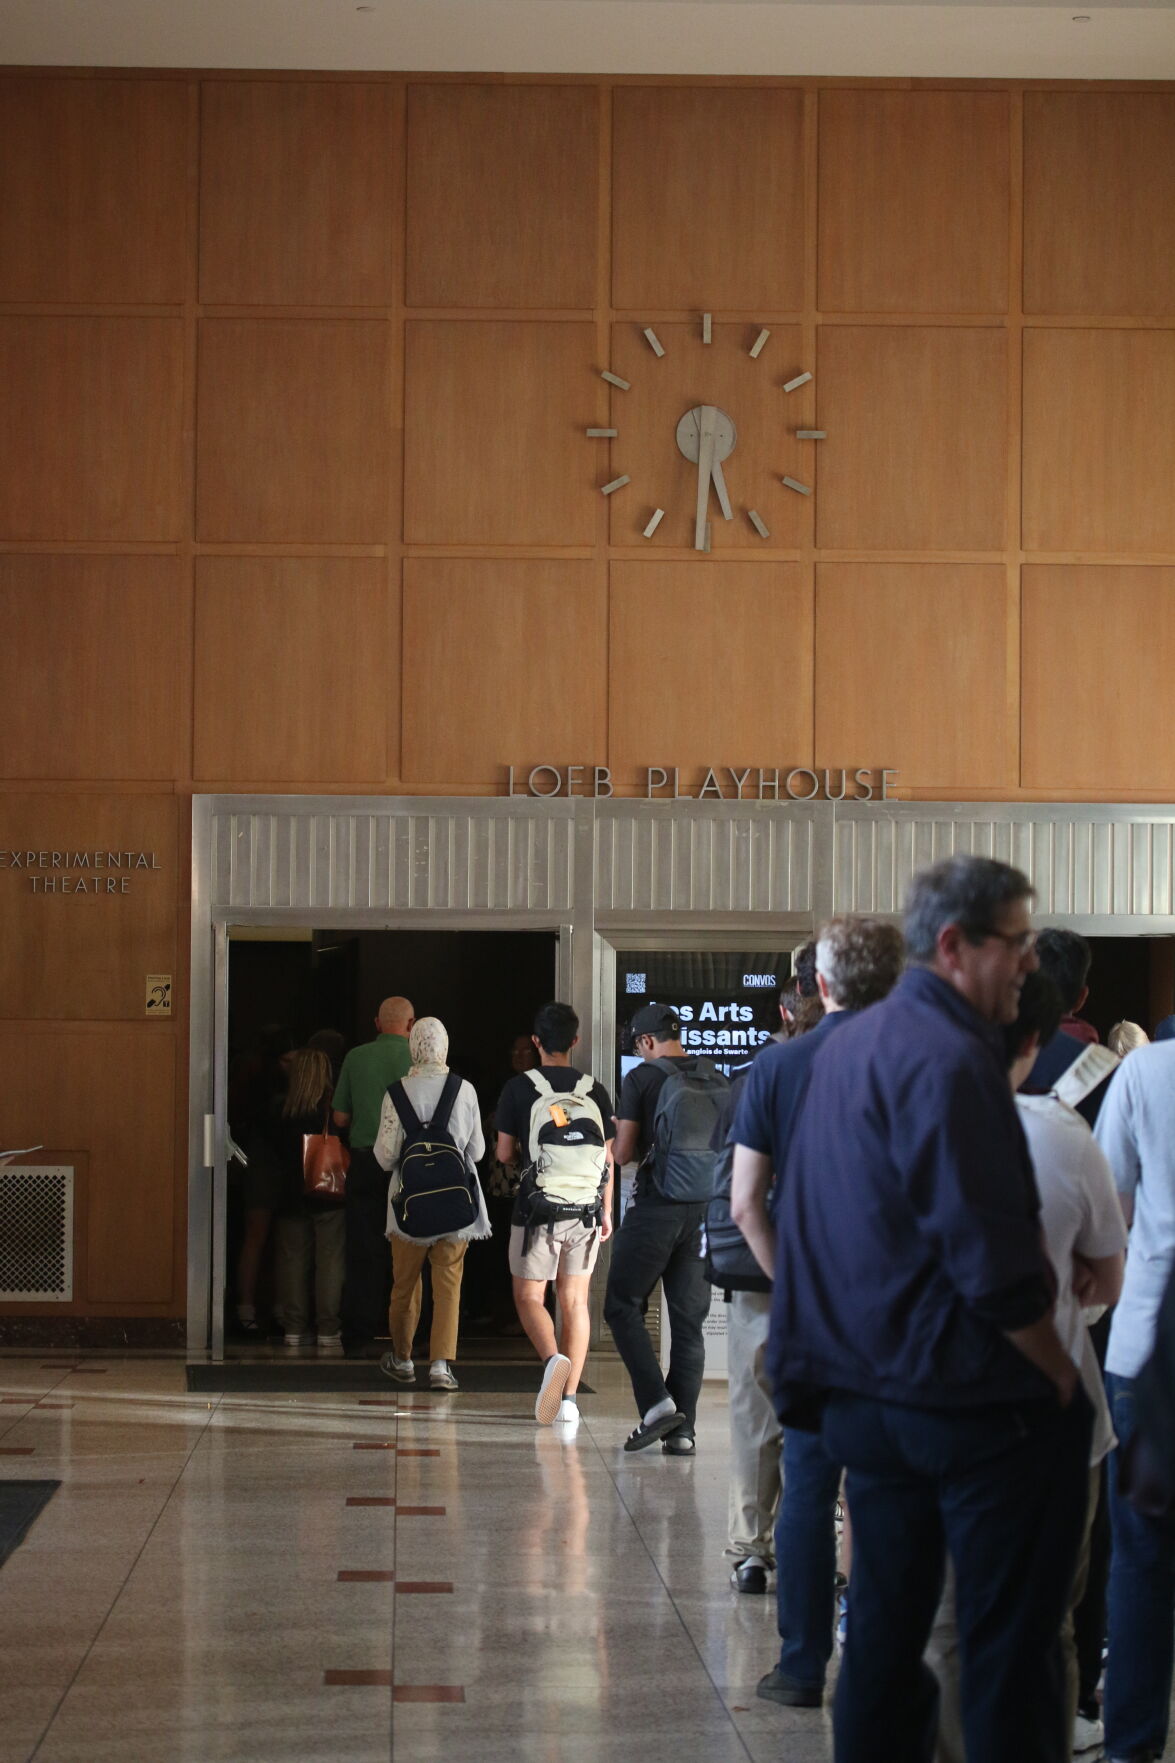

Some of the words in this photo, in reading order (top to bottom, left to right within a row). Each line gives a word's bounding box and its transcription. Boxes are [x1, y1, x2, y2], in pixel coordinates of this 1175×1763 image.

[509, 765, 614, 799] LOEB
[647, 767, 900, 801] PLAYHOUSE
[0, 851, 162, 869] EXPERIMENTAL
[29, 876, 132, 894] THEATRE
[743, 974, 776, 986] CONVOS
[699, 1002, 753, 1022] Arts
[680, 1026, 771, 1046] issants
